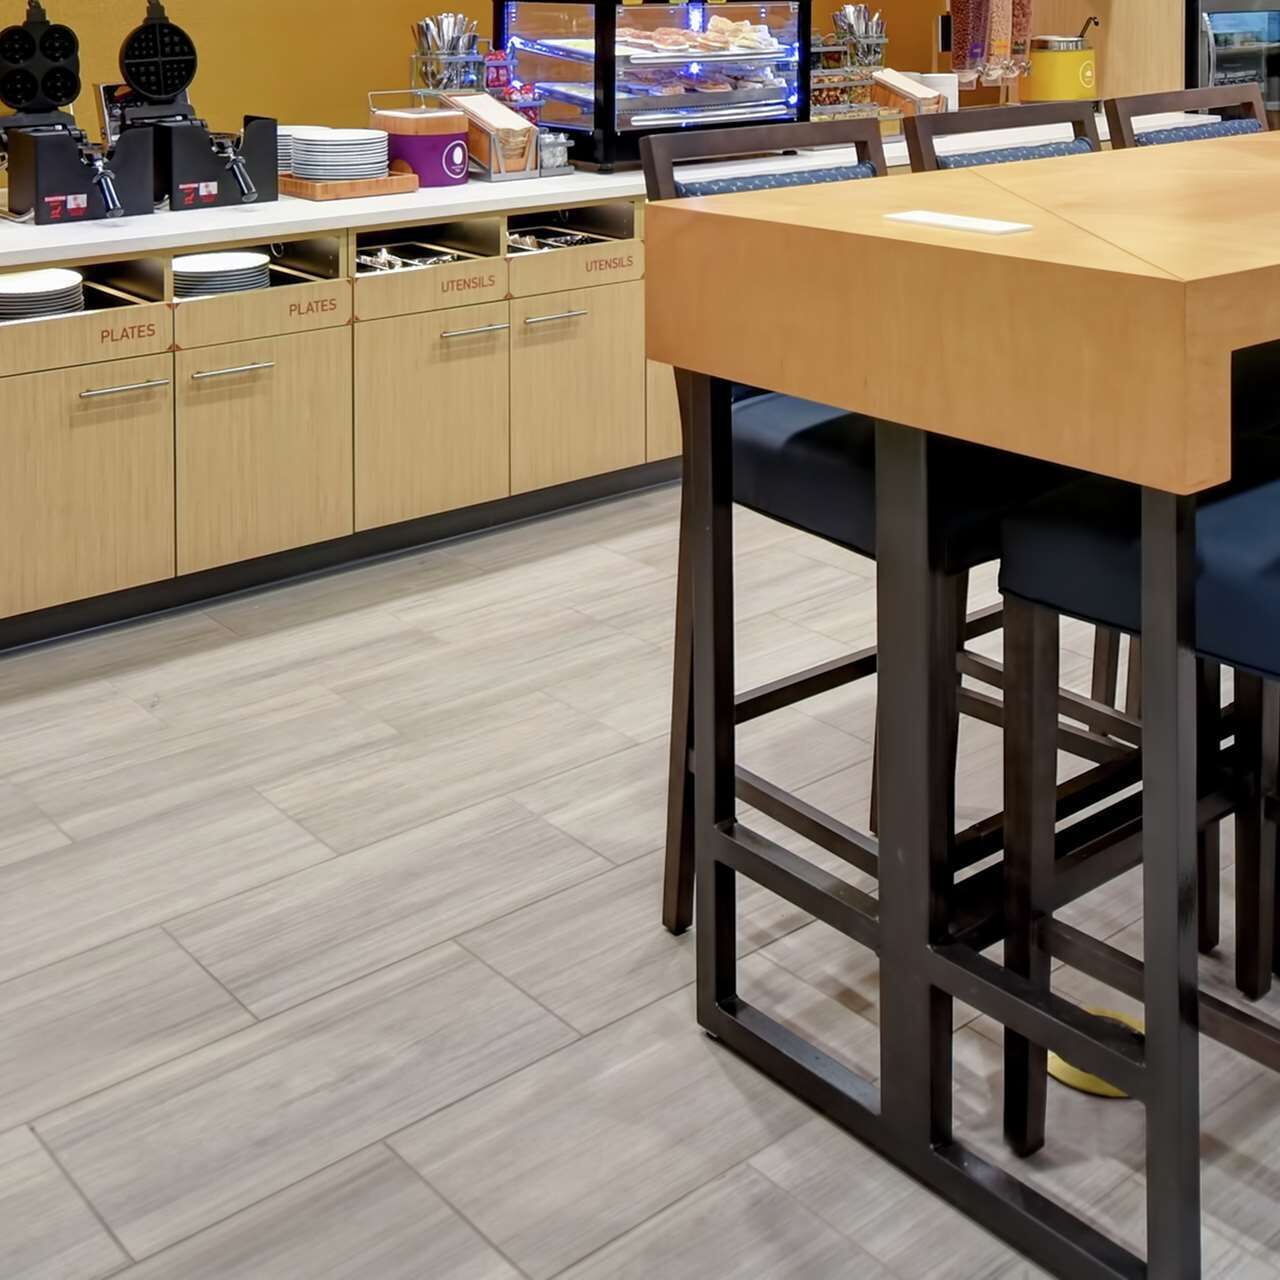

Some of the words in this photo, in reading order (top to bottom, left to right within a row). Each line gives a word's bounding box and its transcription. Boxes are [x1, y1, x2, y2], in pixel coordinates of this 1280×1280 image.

[585, 255, 634, 273] UTENSILS
[441, 274, 496, 293] UTENSILS
[288, 298, 337, 317] PLATES
[100, 323, 156, 344] PLATES
